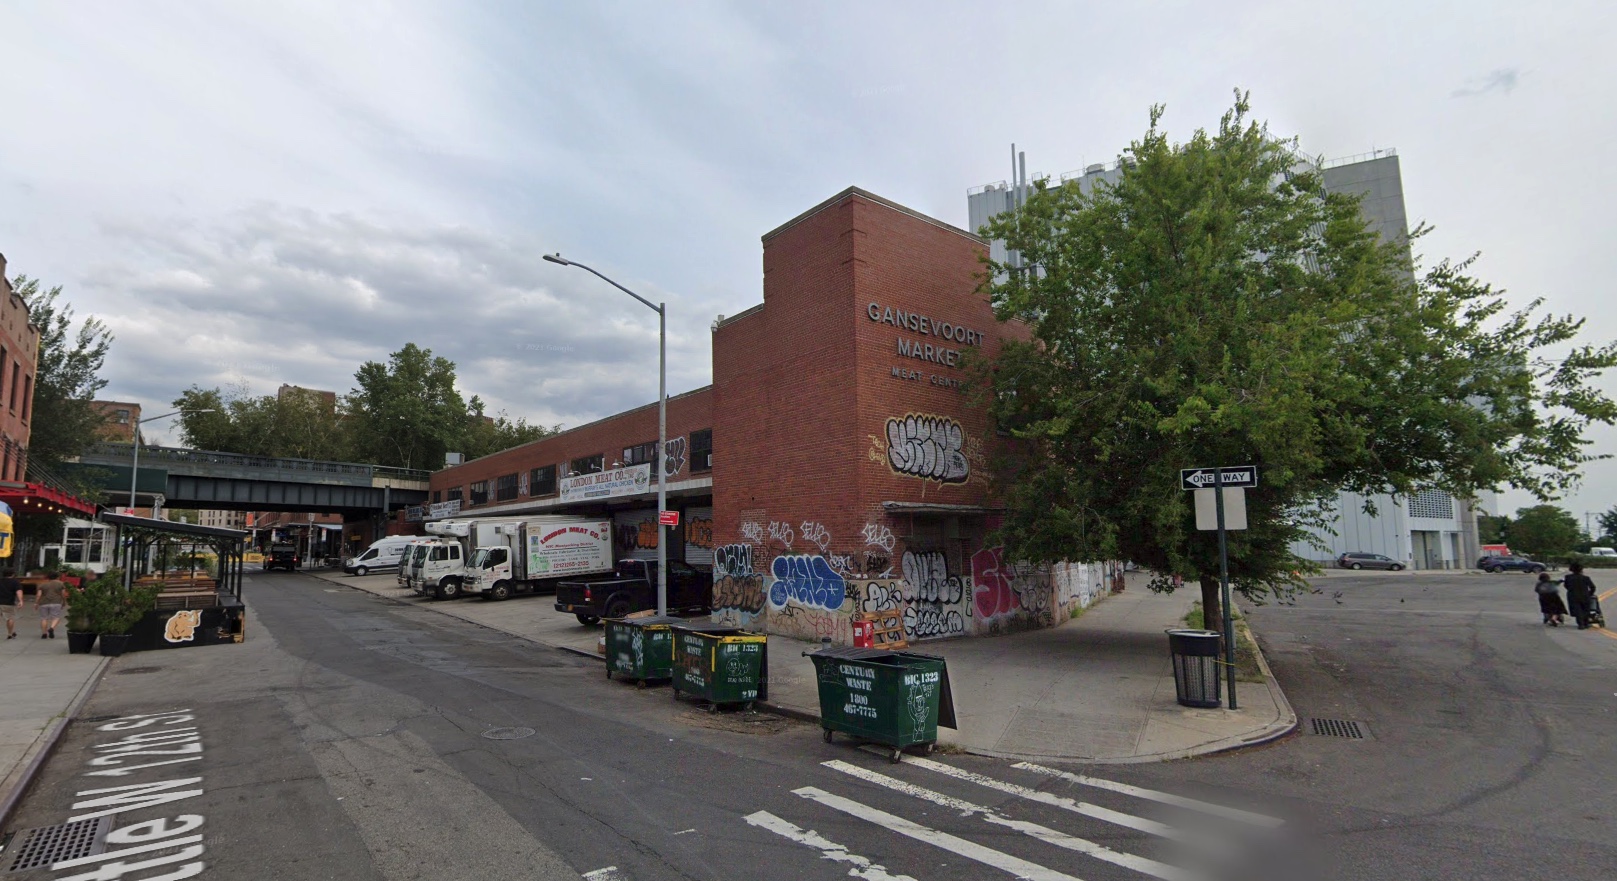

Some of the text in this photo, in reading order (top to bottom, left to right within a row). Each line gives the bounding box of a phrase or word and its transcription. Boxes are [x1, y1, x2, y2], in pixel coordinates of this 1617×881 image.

[868, 302, 985, 346] GANSEVOORT
[892, 366, 923, 382] MEAT
[570, 476, 593, 488] LONDON
[595, 472, 613, 485] MEAT
[1192, 473, 1245, 483] ONE WAY
[540, 527, 567, 544] LONDON
[742, 644, 759, 652] 1323
[839, 664, 876, 679] CENTURY
[904, 671, 939, 686] BIC 1323
[846, 677, 872, 691] WASTE
[849, 692, 868, 706] 1800
[843, 703, 877, 719] 467-7775
